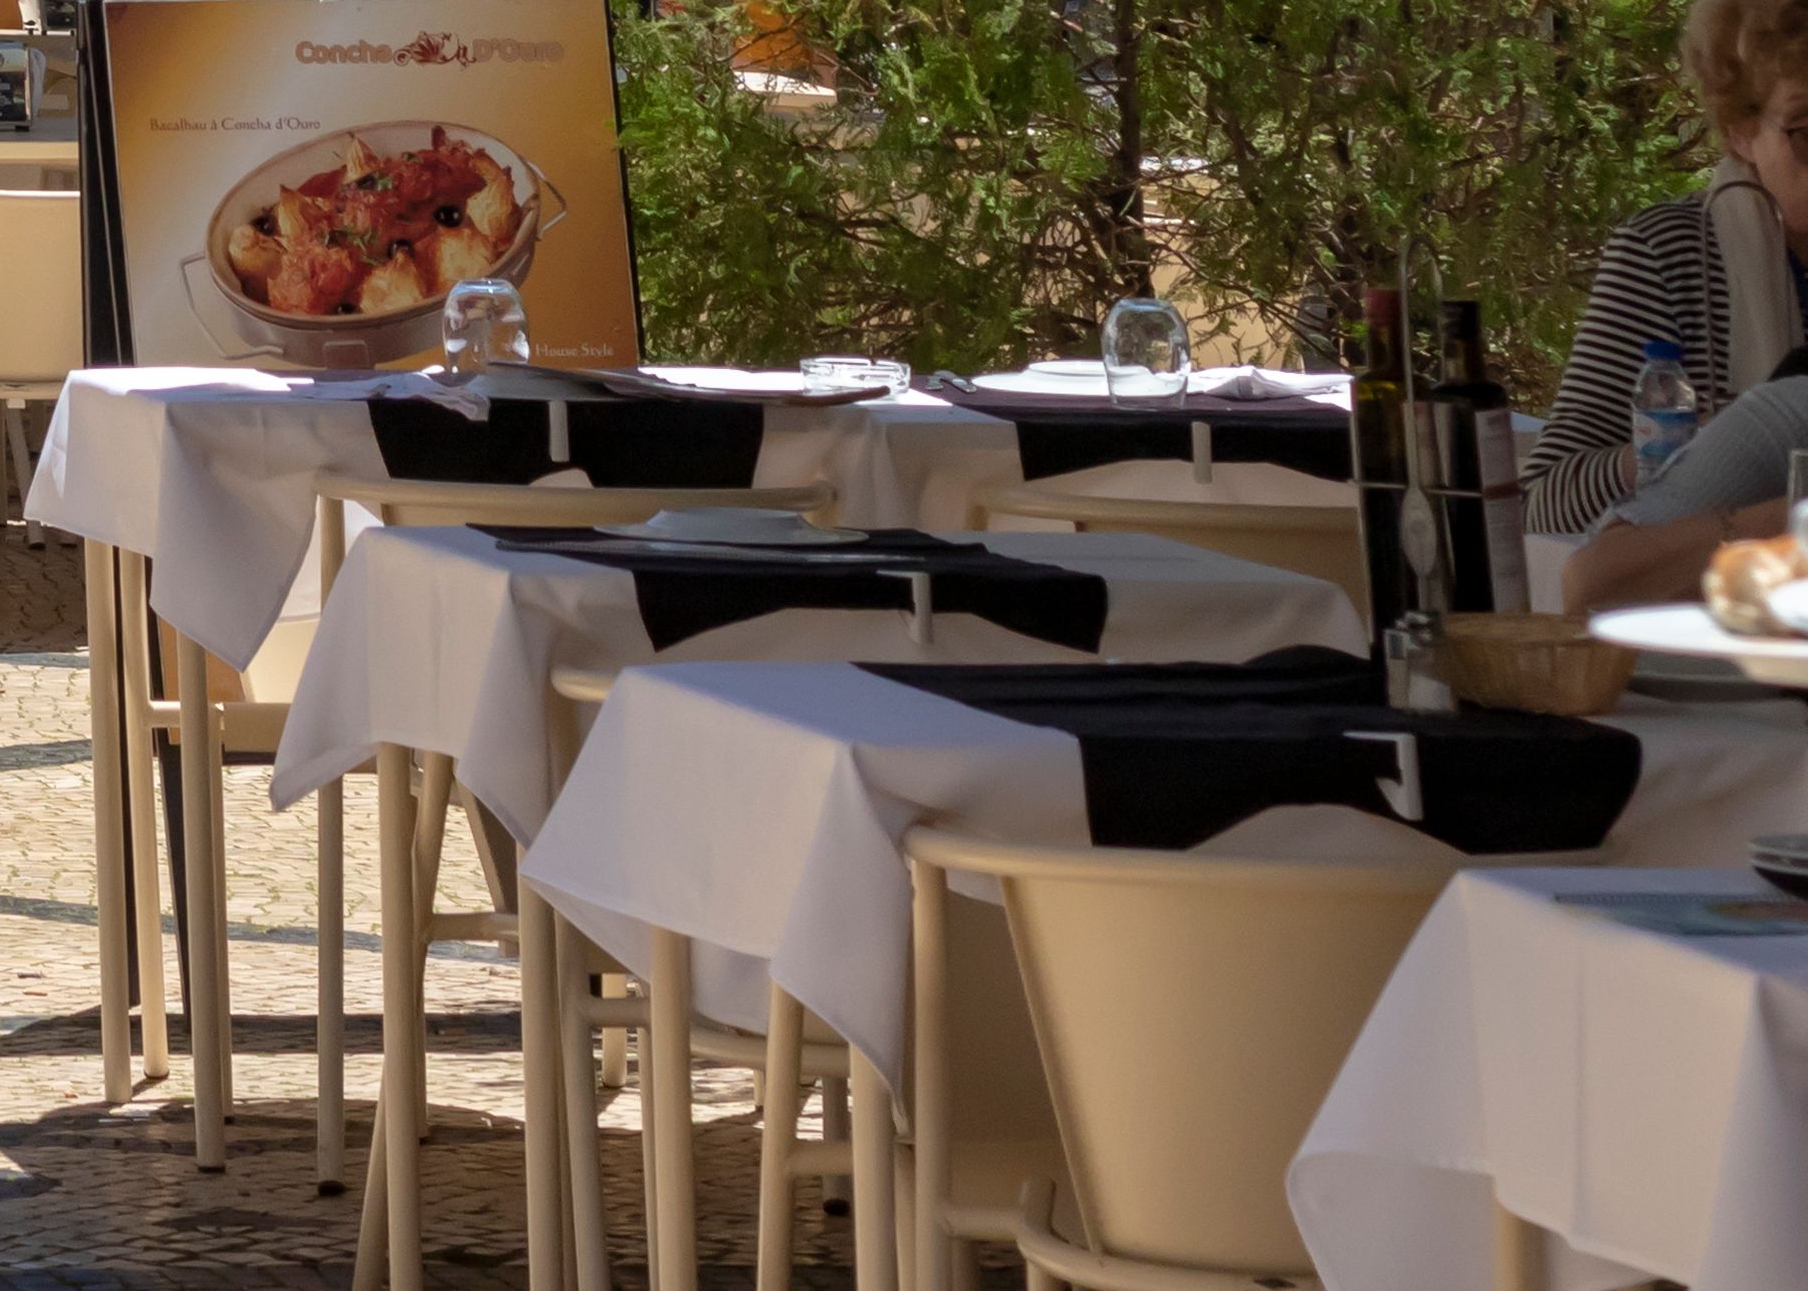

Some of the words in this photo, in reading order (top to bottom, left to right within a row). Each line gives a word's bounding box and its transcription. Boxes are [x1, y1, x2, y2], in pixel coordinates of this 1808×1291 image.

[149, 118, 207, 132] Bacalhau
[221, 117, 272, 131] Concha
[275, 116, 321, 130] d'Ouro
[536, 344, 578, 357] House
[580, 343, 614, 358] Style
